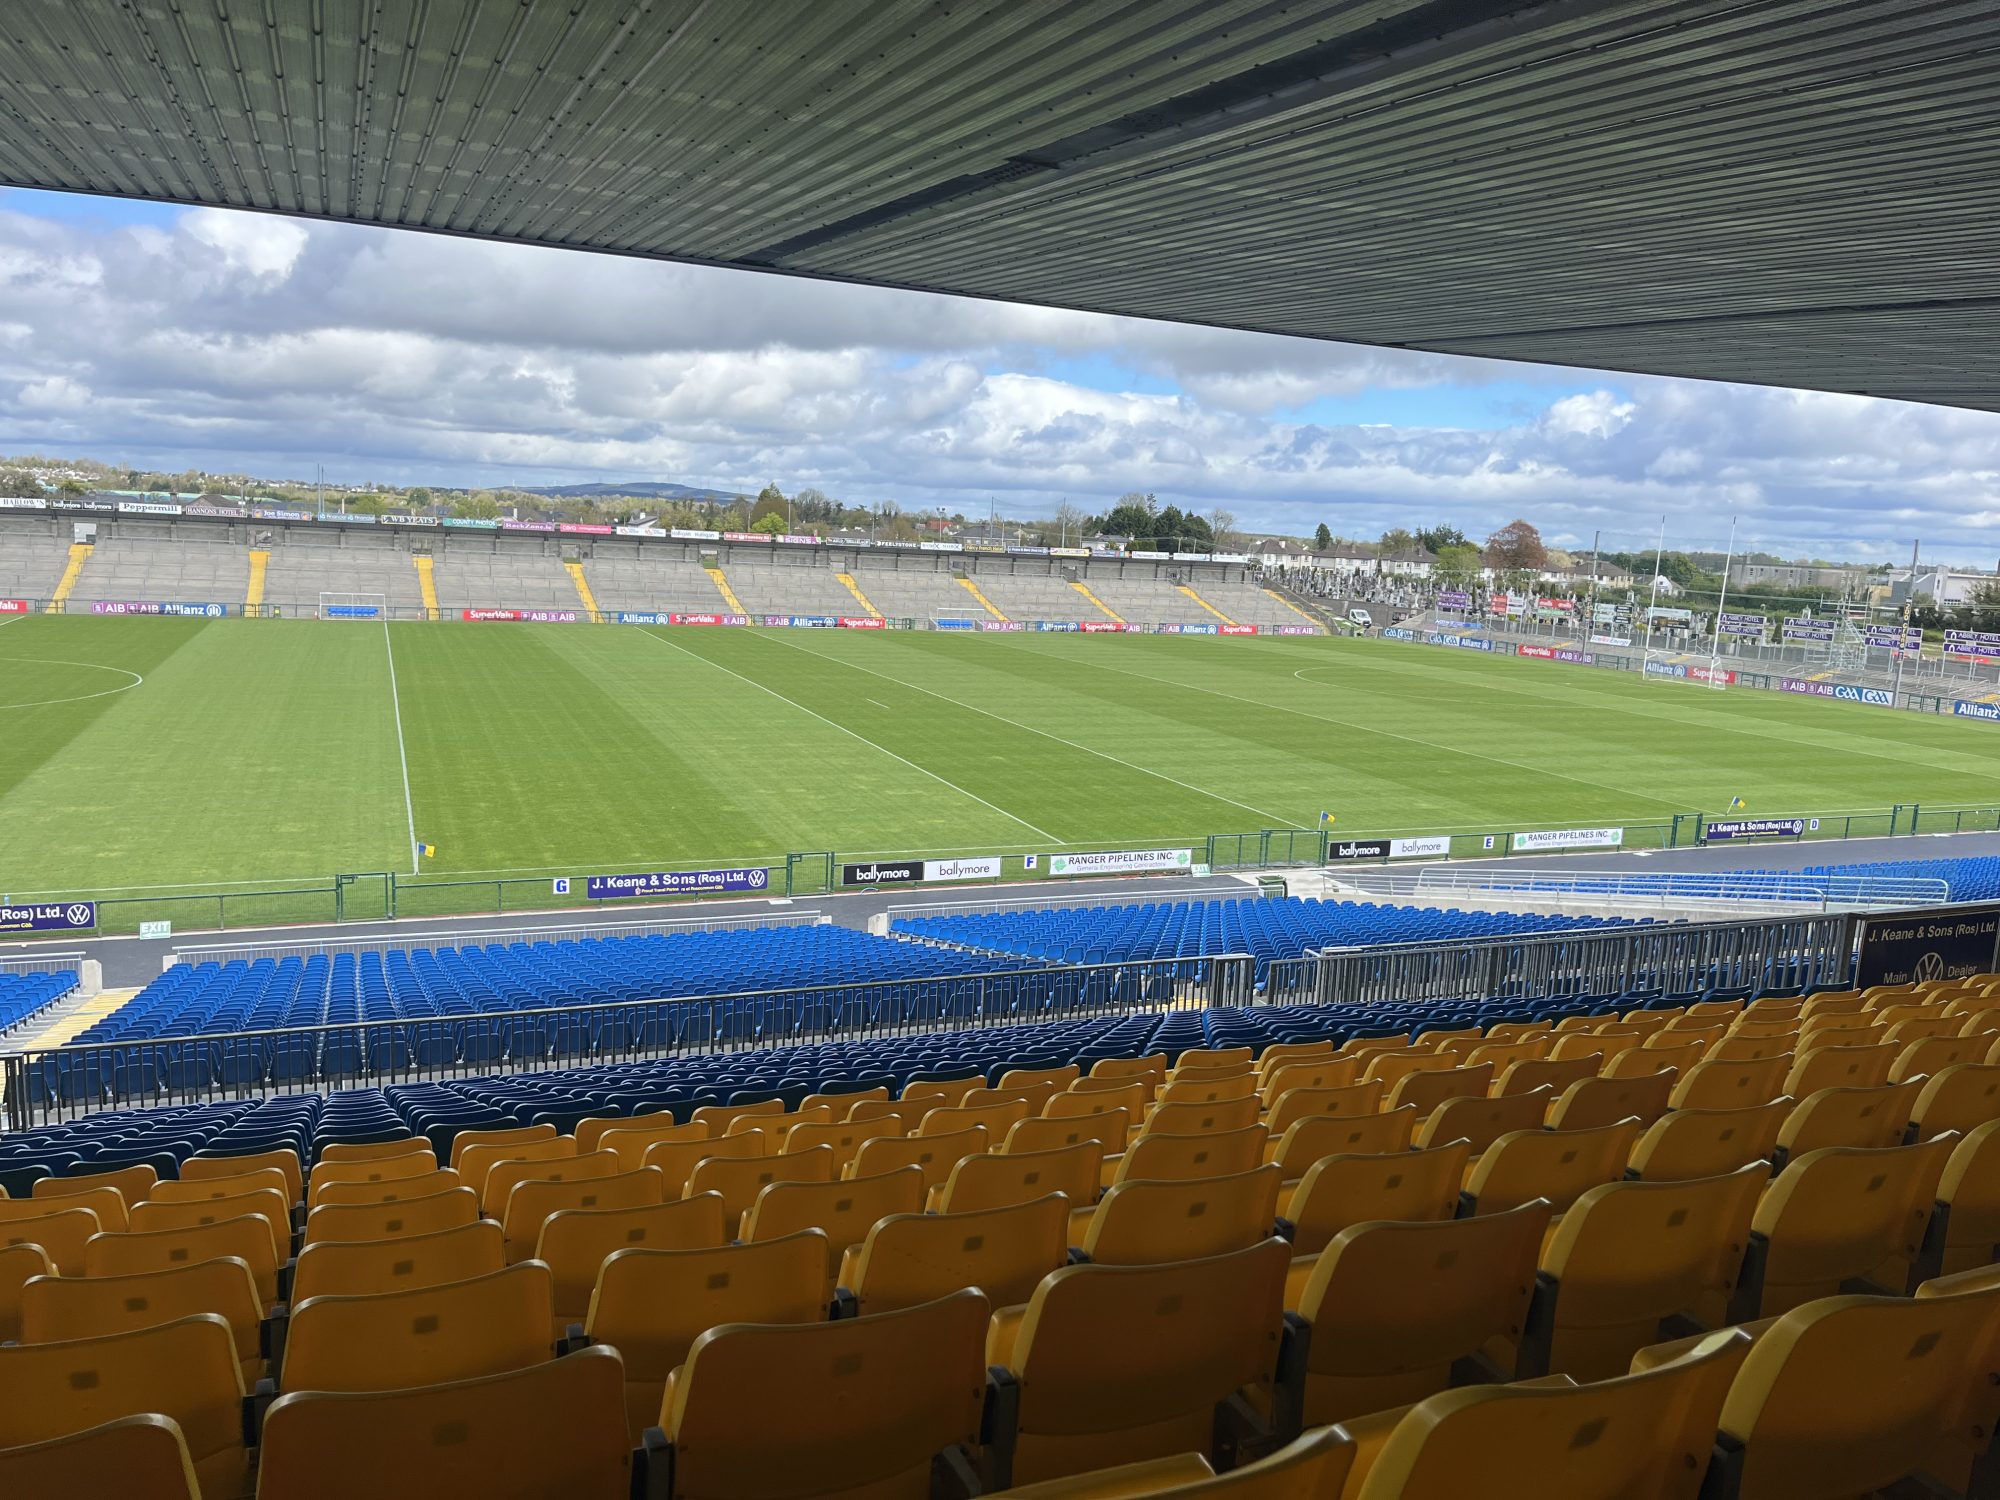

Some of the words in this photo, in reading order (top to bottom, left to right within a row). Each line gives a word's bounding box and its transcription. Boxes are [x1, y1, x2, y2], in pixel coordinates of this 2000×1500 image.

[124, 503, 178, 512] Peppermill
[407, 516, 434, 524] YEATS
[105, 602, 125, 613] AIB
[164, 604, 204, 615] Allianz
[470, 610, 514, 620] SuperValu
[531, 612, 548, 621] AIB
[559, 613, 576, 622] AIB
[622, 614, 654, 624] Allianz
[730, 616, 746, 625] AIB
[1746, 616, 1760, 624] HOTEL
[774, 617, 790, 626] AIB
[844, 618, 880, 627] SuperValu
[987, 622, 1000, 630] AIB
[1813, 620, 1830, 628] HOTEL
[1183, 625, 1206, 634] Allianz
[1223, 625, 1252, 633] SuperValu
[1284, 626, 1295, 634] AIB
[1812, 633, 1828, 641] HOTEL
[1958, 632, 1978, 641] ABBEY
[1980, 634, 2000, 643] HOTEL
[1462, 638, 1482, 649] Allianz
[1876, 640, 1894, 648] ABBEY
[1522, 646, 1550, 658] SuperValu
[1561, 652, 1573, 661] AIB
[1956, 646, 1976, 654] ABBEY
[1978, 647, 1998, 656] HOTEL
[1646, 662, 1673, 675] Allianz
[1790, 681, 1806, 693] AIB
[1816, 685, 1834, 697] AIB
[1958, 703, 1998, 720] Allianz
[1710, 824, 1716, 833] J.
[1718, 823, 1738, 833] Keane
[1740, 822, 1746, 830] &
[1746, 822, 1765, 831] Sons
[1766, 821, 1781, 831] (Ros)
[1781, 820, 1792, 829] Ltd.
[1812, 820, 1818, 829] D
[1528, 832, 1558, 842] RANGER
[1558, 830, 1594, 840] PIPELINES
[1402, 840, 1442, 854] ballymore
[1486, 838, 1492, 848] E
[1338, 842, 1380, 858] ballymore
[1026, 856, 1034, 868] F
[1068, 854, 1106, 865] RANGER
[1108, 852, 1154, 864] PIPELINES
[1156, 852, 1174, 861] INC.
[940, 861, 990, 878] ballymore
[1076, 864, 1098, 872] General
[1100, 862, 1132, 872] Engineering
[1134, 861, 1166, 870] Contractors
[856, 864, 910, 883] ballymore
[592, 878, 604, 889] J.
[607, 877, 647, 888] Keane
[650, 875, 660, 886] &
[662, 874, 696, 886] Sons
[698, 872, 725, 886] (Ros)
[726, 871, 746, 882] Ltd.
[556, 880, 567, 892] G
[36, 906, 64, 919] Ltd.
[142, 922, 168, 934] EXIT
[1868, 928, 1878, 942] J.
[1881, 928, 1914, 942] Keane
[1916, 925, 1924, 938] &
[1927, 924, 1952, 938] Sons
[1955, 922, 1979, 938] (Ros)
[1980, 920, 1996, 934] Ltd.
[1883, 971, 1908, 984] Main
[1947, 964, 1978, 978] Dealer
